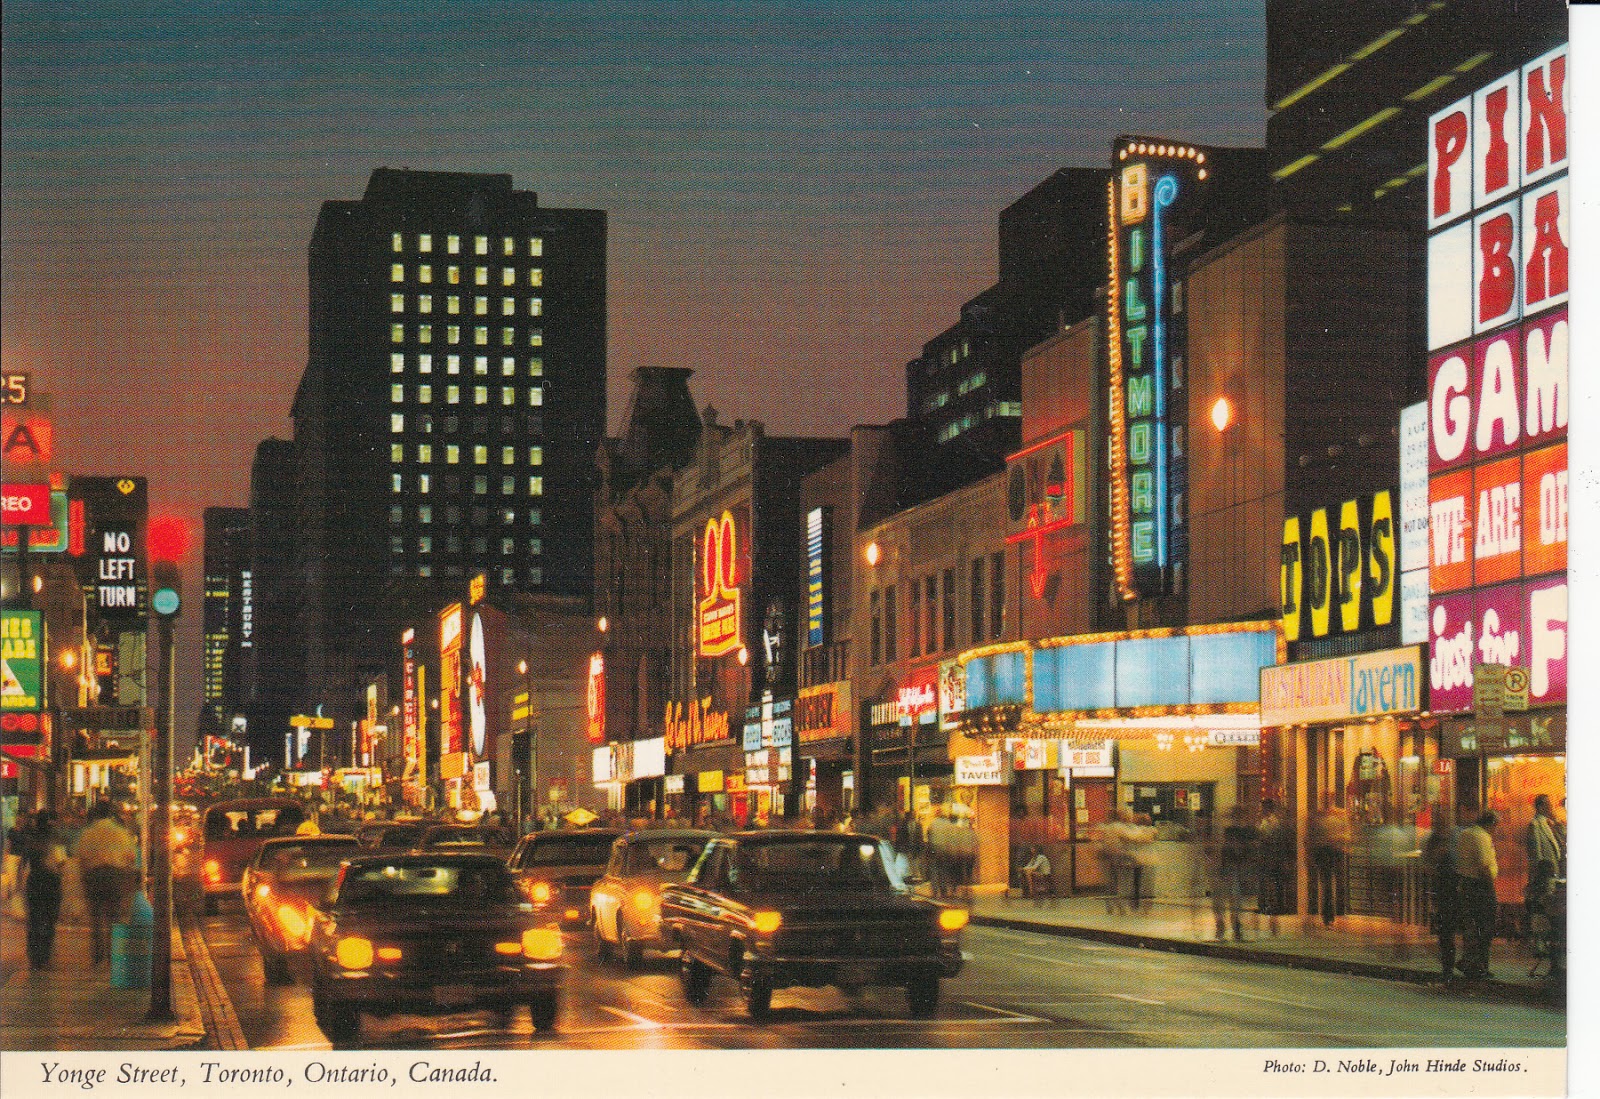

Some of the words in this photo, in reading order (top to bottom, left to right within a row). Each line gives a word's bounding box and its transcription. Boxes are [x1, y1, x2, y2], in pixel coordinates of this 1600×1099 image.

[1433, 54, 1568, 218] PIN
[1479, 190, 1568, 324] BA
[1, 375, 26, 402] 5
[1120, 163, 1153, 563] BILTMORE
[1431, 320, 1568, 461] GAM
[104, 531, 130, 553] NO
[1281, 514, 1391, 614] TOPS
[1430, 496, 1466, 567] WE
[1475, 482, 1521, 559] ARE
[98, 586, 136, 607] TURN
[99, 558, 135, 580] LEFT
[1348, 658, 1415, 715] Tavern
